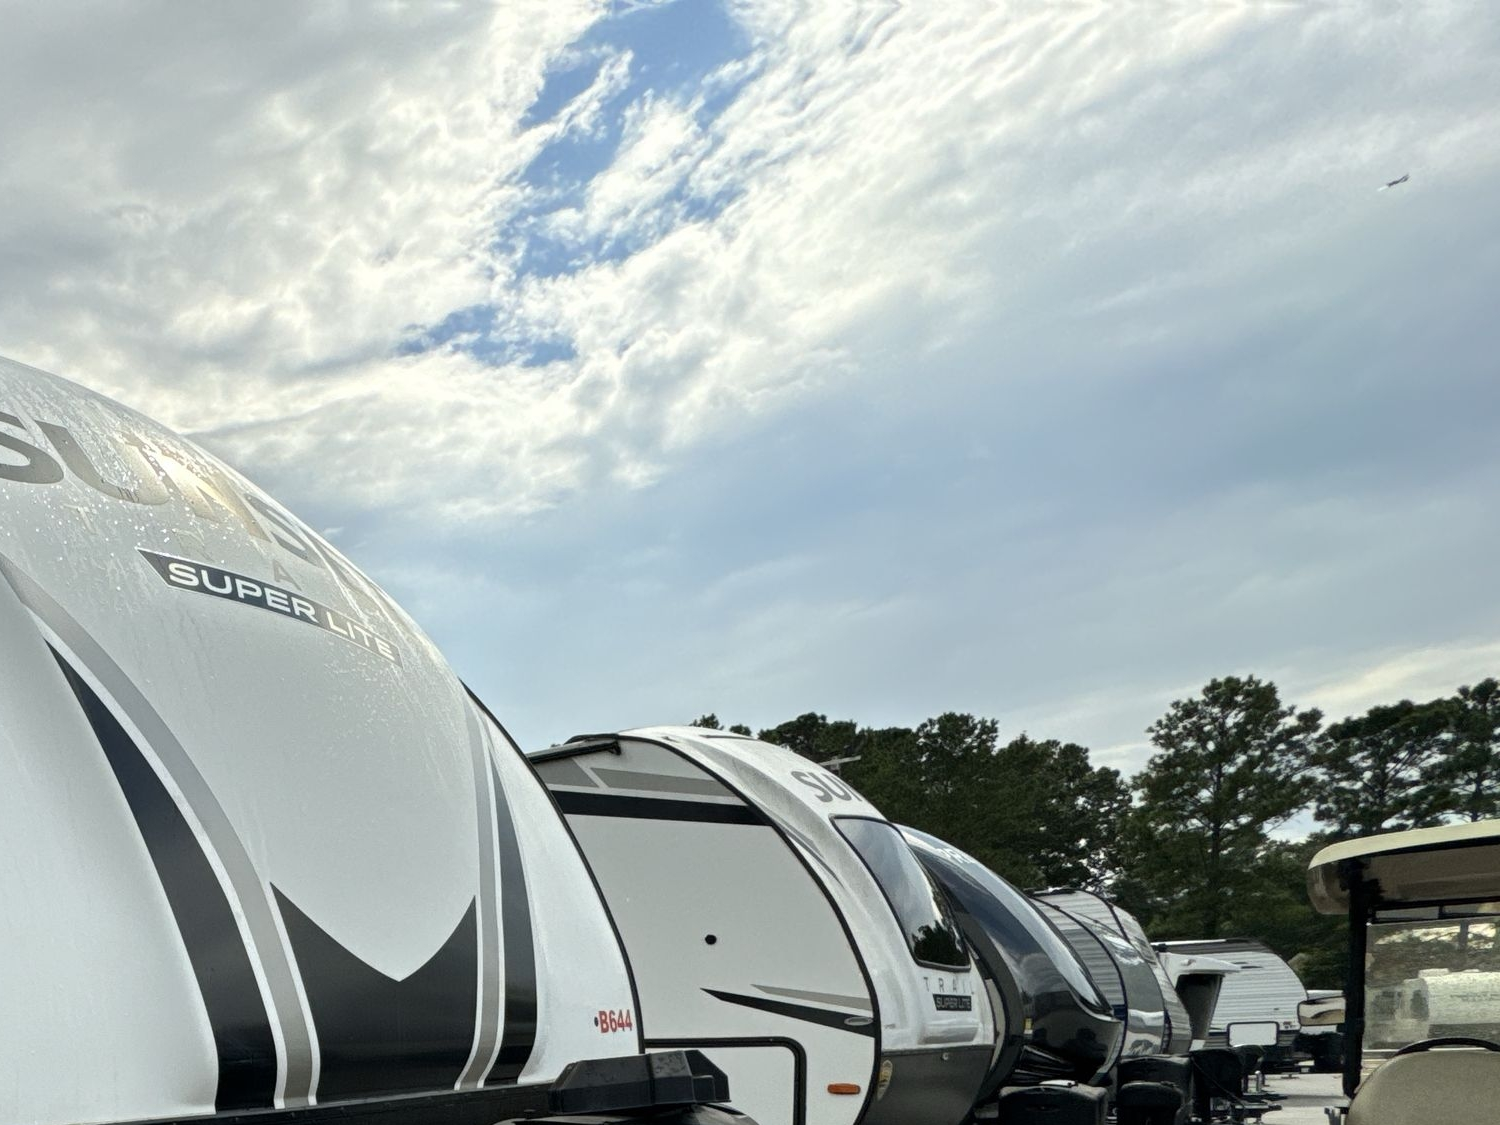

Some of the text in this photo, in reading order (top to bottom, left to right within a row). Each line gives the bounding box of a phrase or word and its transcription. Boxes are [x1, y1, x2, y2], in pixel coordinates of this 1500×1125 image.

[168, 562, 396, 661] SUPER LITE
[598, 1009, 633, 1034] B644
